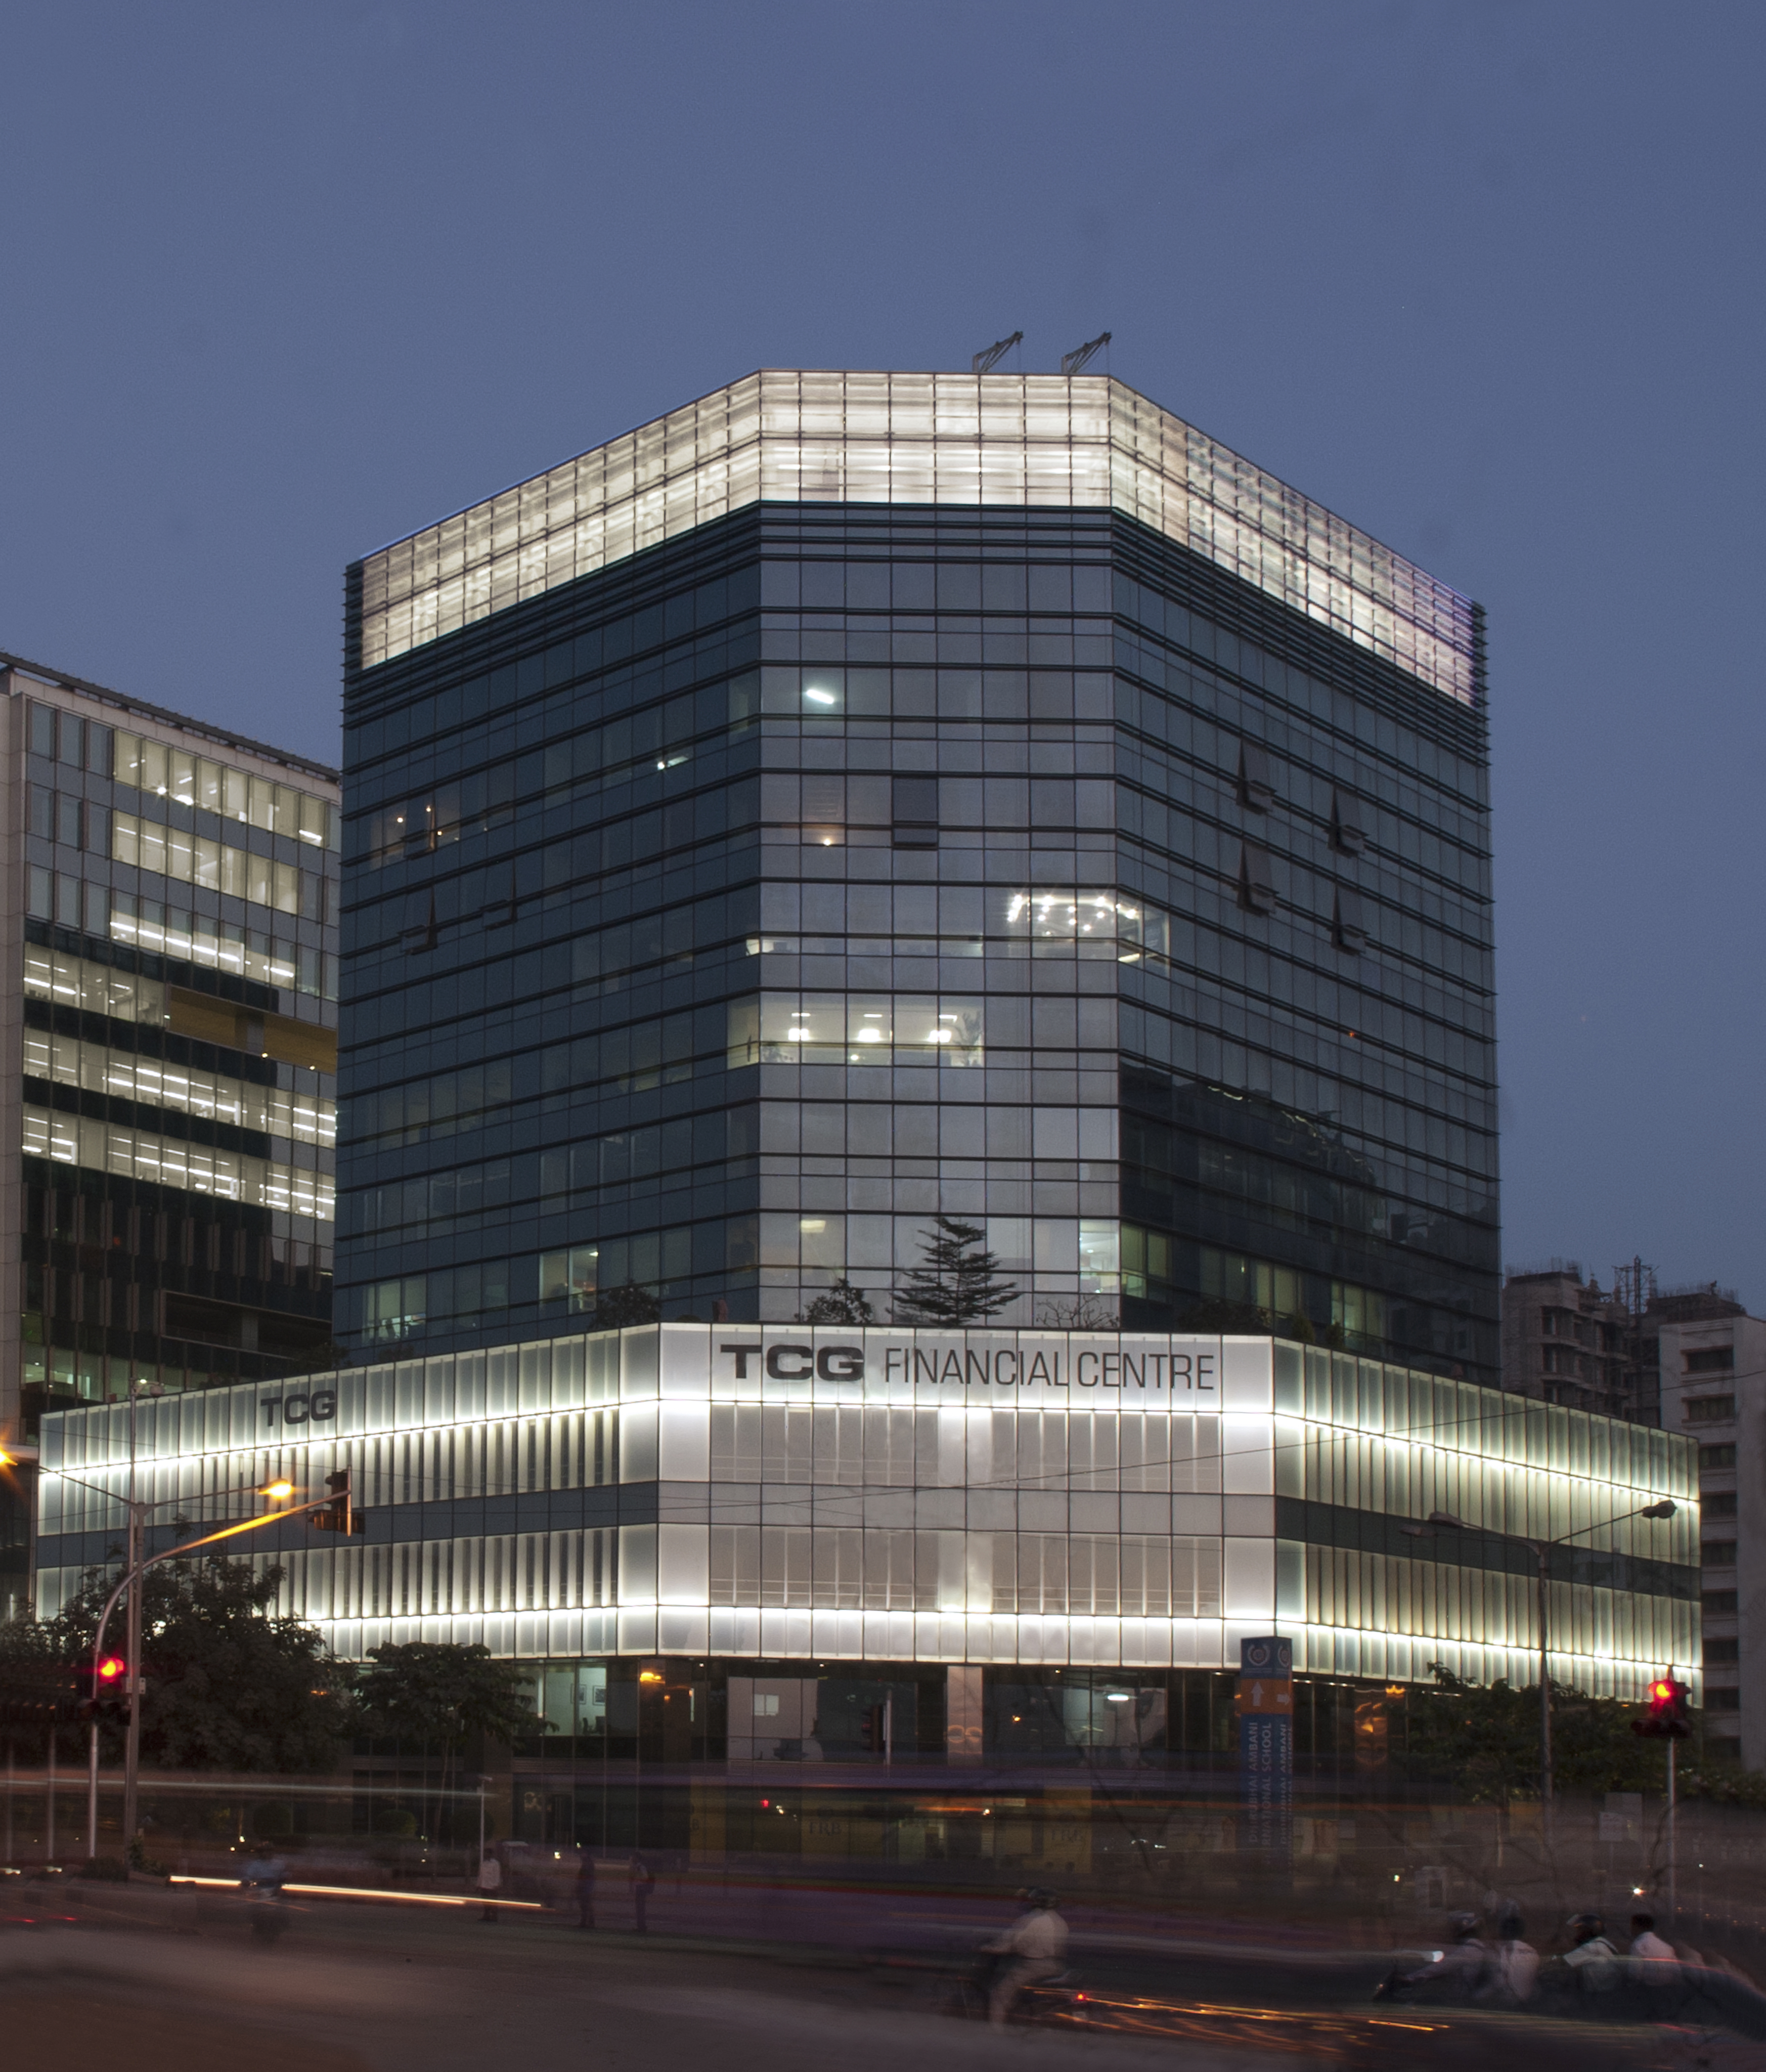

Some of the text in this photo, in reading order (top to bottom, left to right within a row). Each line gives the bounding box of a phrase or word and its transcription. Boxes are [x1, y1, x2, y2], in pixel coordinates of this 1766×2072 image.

[720, 1344, 1214, 1390] TCG FINANCIAL CENTRE
[260, 1390, 336, 1427] TCG
[1261, 1722, 1272, 1772] SCHOOL
[1248, 1722, 1258, 1843] DHIRUBHAI AMBANI
